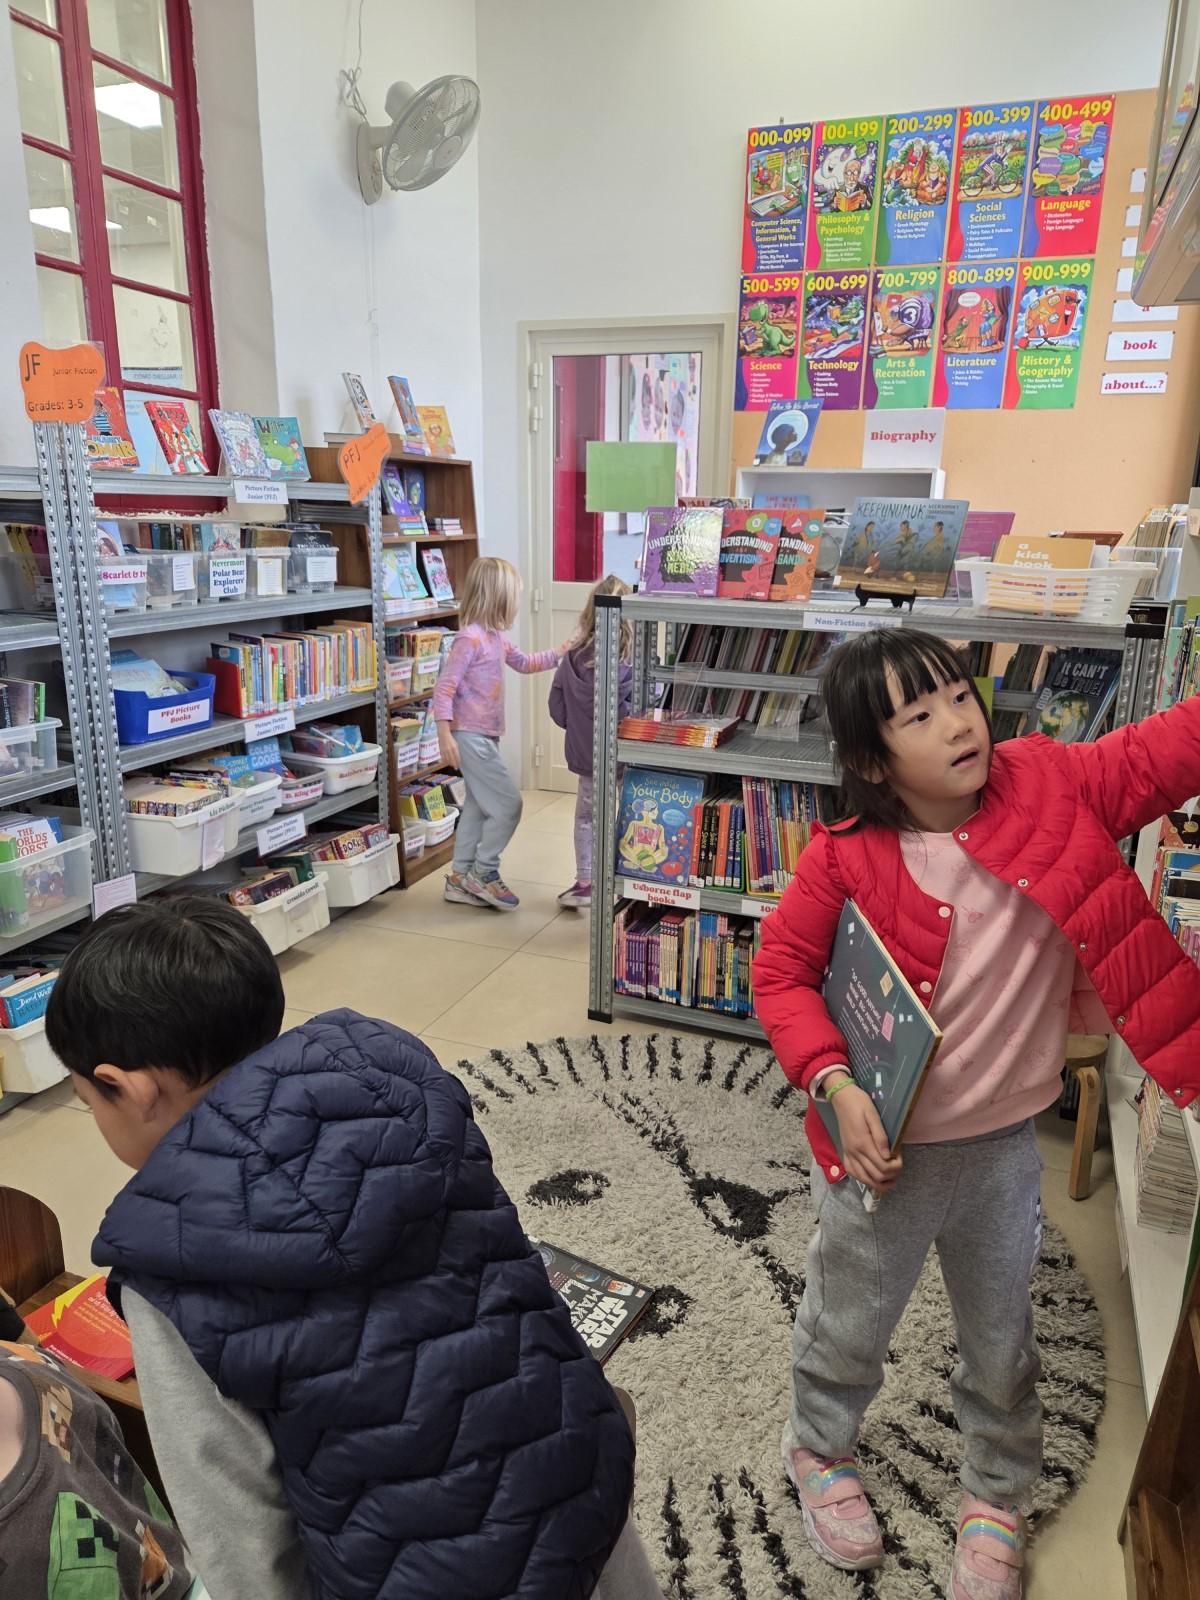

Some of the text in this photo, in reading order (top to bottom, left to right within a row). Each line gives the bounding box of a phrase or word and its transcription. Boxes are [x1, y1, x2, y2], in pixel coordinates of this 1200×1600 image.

[963, 106, 1031, 128] 300-399
[1039, 100, 1113, 121] 400-499
[822, 121, 878, 140] 100-199
[889, 114, 953, 135] 200-299
[750, 127, 811, 146] 000-099
[976, 202, 1002, 212] Social
[1040, 199, 1091, 212] Language
[817, 212, 870, 225] Philosophy &
[895, 209, 935, 222] Religion
[969, 212, 1006, 223] Sciences
[752, 218, 802, 228] Computer Science,
[756, 225, 791, 234] Information,
[756, 232, 796, 242] General Works
[821, 225, 864, 237] Psychology
[947, 267, 1014, 285] 800-899
[1022, 263, 1091, 281] 900-999
[742, 277, 800, 294] 500-599
[806, 275, 868, 291] 600-699
[877, 271, 937, 288] 700-799
[904, 307, 916, 323] 3
[1123, 340, 1157, 350] book
[750, 361, 782, 370] Science
[808, 360, 859, 371] Technology
[886, 358, 916, 368] Arts &
[947, 357, 997, 367] Literature
[1023, 354, 1072, 366] History &
[25, 353, 41, 382] JF
[52, 367, 97, 376] Junior Fiction
[875, 368, 925, 378] Recreation
[1018, 366, 1073, 378] Geography
[1104, 380, 1164, 390] about...?
[28, 398, 84, 412] Grades: 3-5
[871, 430, 937, 443] Biography
[343, 443, 360, 469] PFJ
[721, 536, 774, 553] DERSTANDING
[778, 538, 815, 554] TANDING
[1016, 550, 1049, 560] kids
[1013, 559, 1053, 569] book
[102, 569, 132, 580] Scarlet
[213, 569, 231, 577] Polar
[223, 586, 239, 594] Club
[814, 617, 866, 627] Non-Fiction
[1072, 663, 1109, 680] CAN'T
[1070, 677, 1105, 696] TRUE!
[160, 703, 201, 719] PFJ Picture
[170, 713, 192, 724] Books
[252, 753, 281, 768] GOOSE
[631, 781, 693, 809] Your Body
[17, 827, 35, 837] THE
[16, 832, 48, 847] ORLD'S
[632, 883, 692, 899] Usborne flap
[647, 894, 676, 905] books
[576, 1296, 620, 1340] WAR
[585, 1299, 628, 1349] STAR
